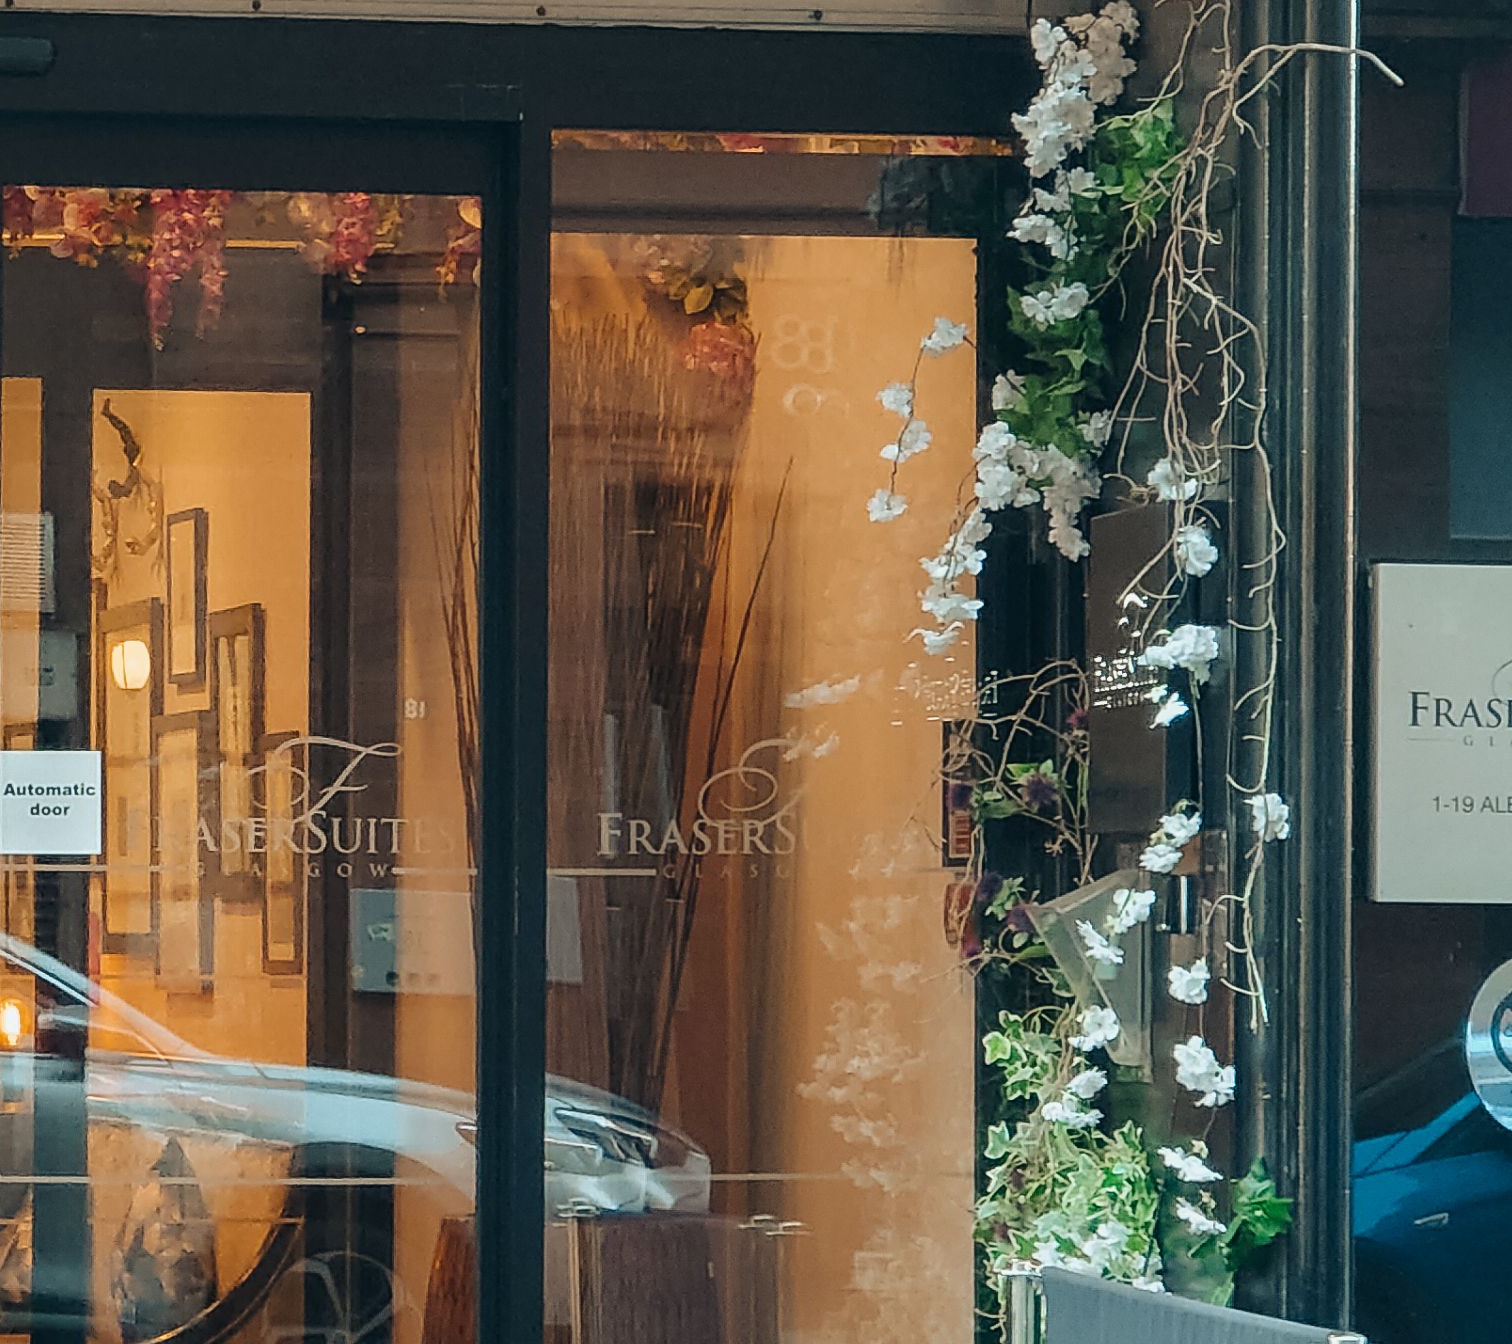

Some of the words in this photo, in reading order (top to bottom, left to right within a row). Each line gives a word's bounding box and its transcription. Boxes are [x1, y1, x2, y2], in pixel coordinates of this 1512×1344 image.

[1408, 690, 1512, 728] FRAS
[3, 782, 96, 798] Automatic
[29, 803, 70, 818] door
[1432, 795, 1474, 814] 1-19
